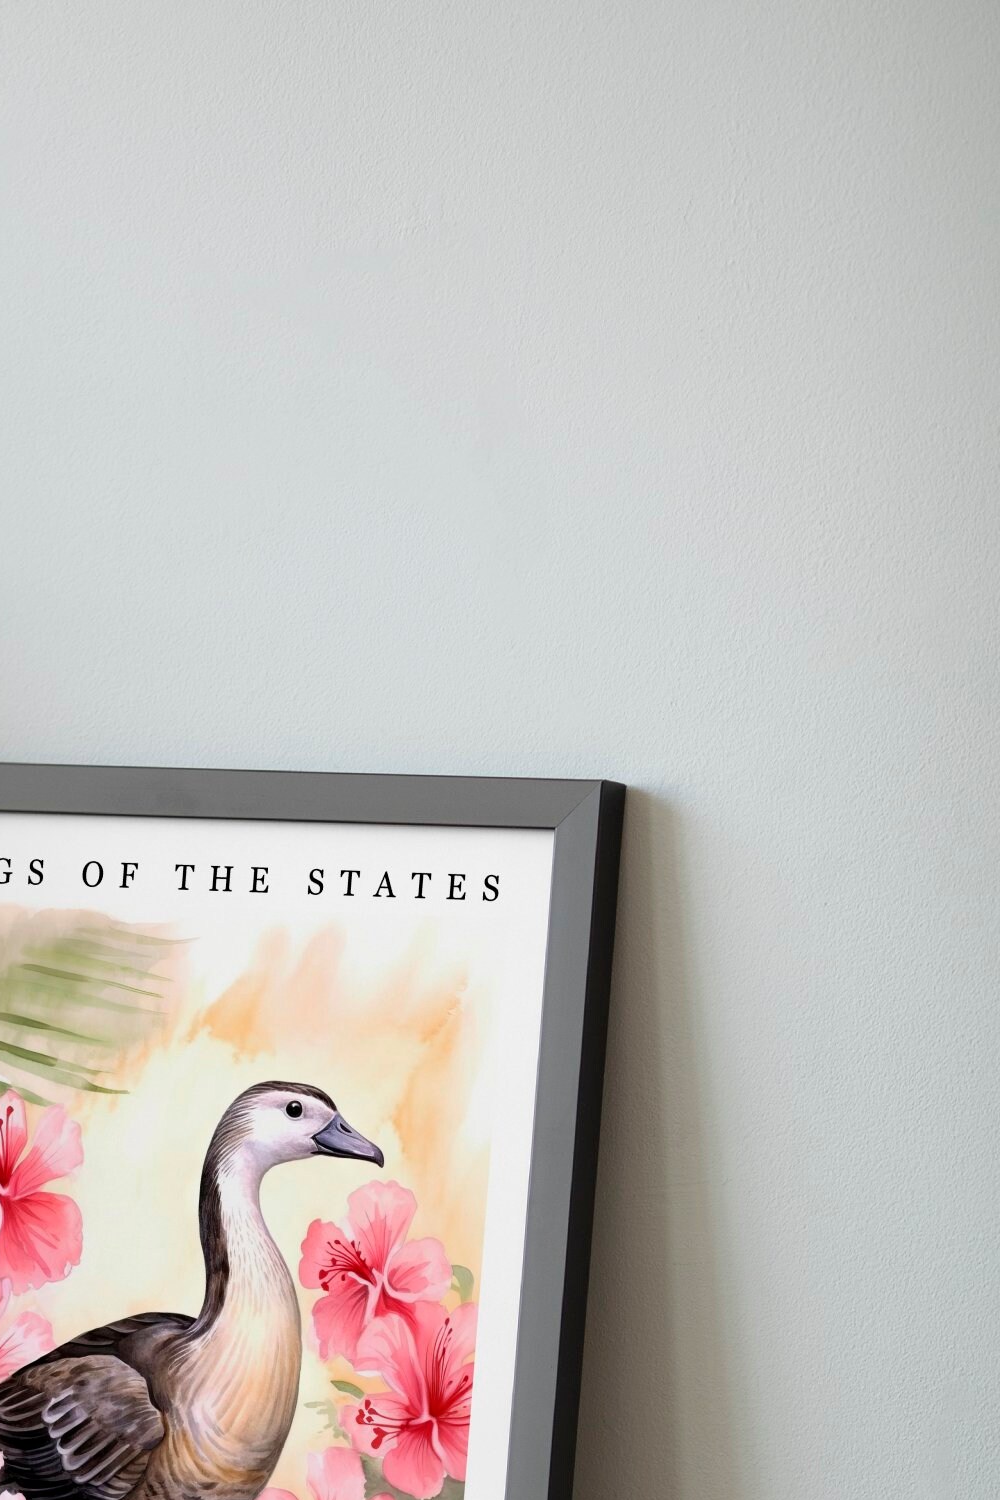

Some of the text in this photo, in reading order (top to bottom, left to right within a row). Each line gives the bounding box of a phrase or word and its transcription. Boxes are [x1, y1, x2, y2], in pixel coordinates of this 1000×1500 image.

[81, 860, 139, 889] OF
[174, 863, 269, 894] THE
[307, 868, 500, 902] STATES
